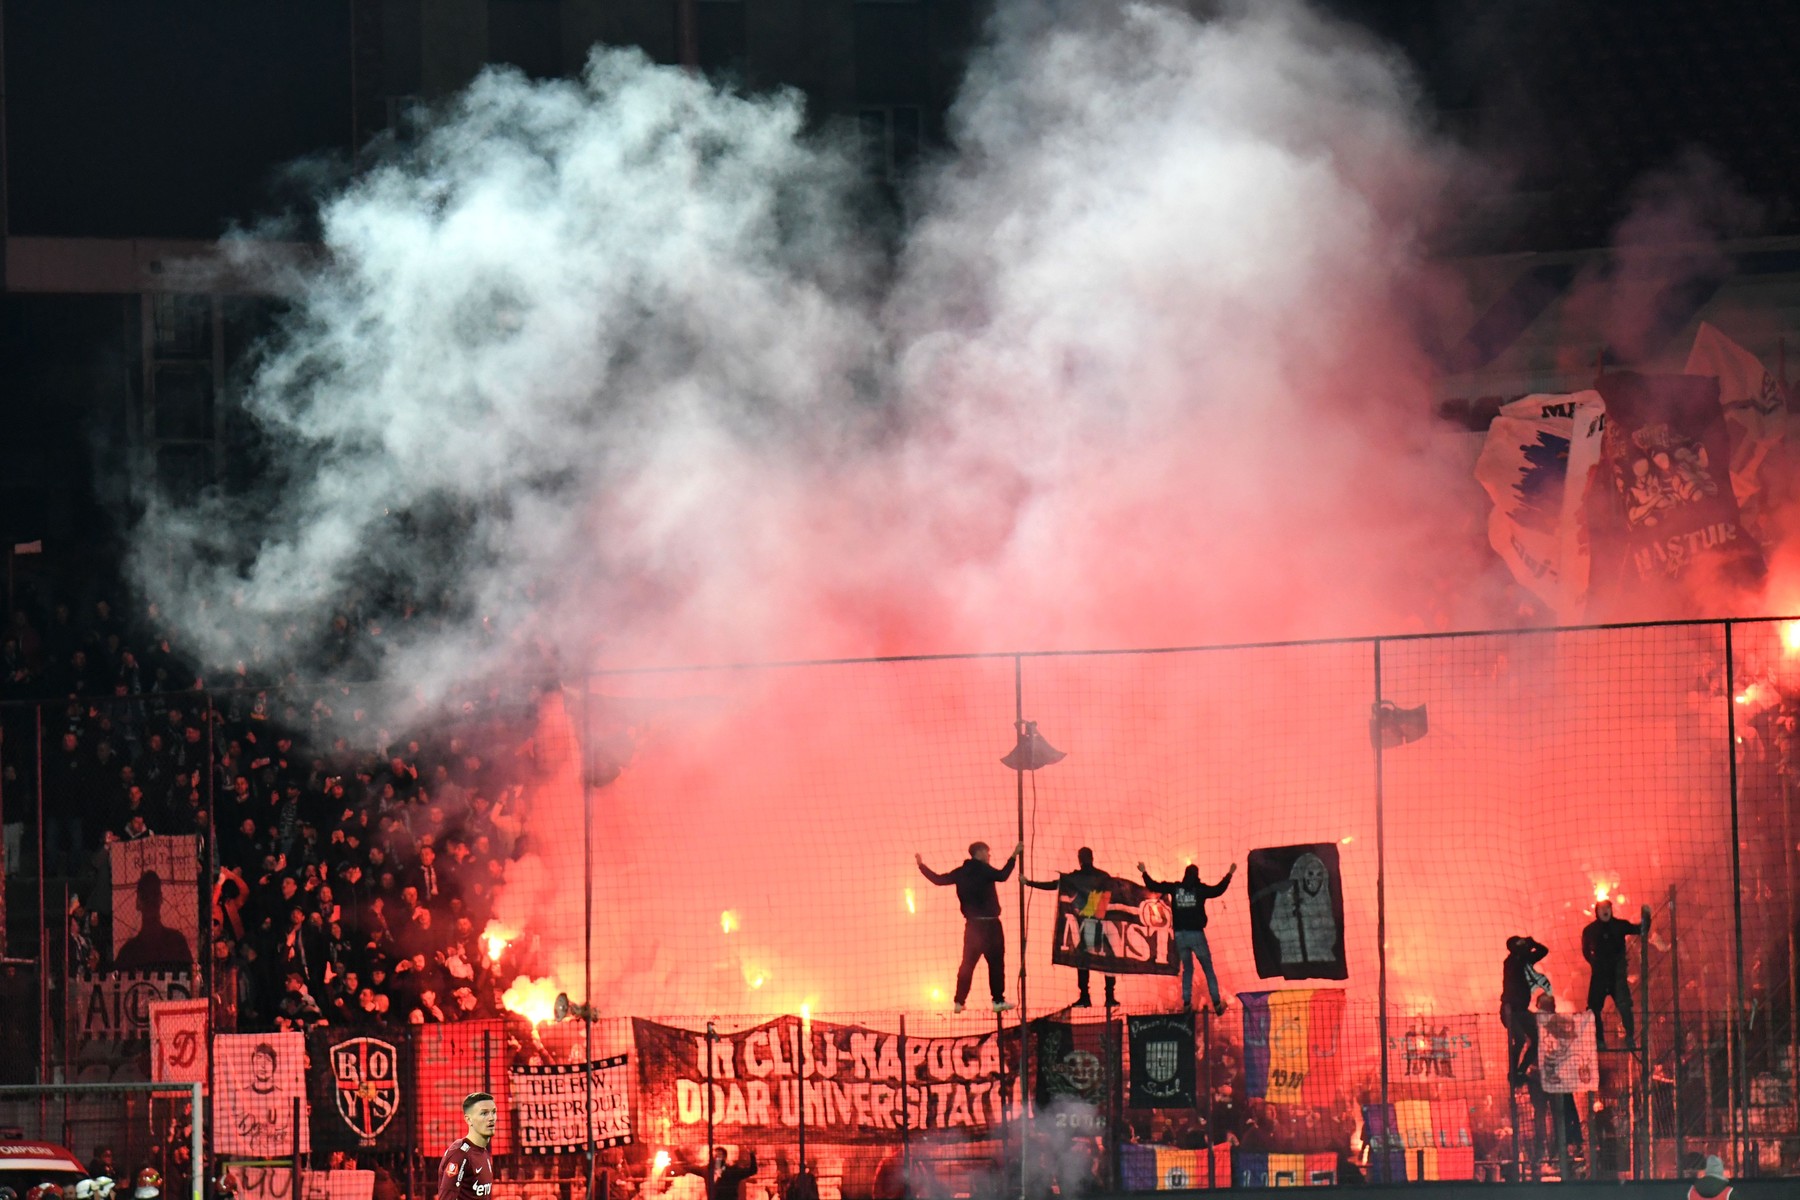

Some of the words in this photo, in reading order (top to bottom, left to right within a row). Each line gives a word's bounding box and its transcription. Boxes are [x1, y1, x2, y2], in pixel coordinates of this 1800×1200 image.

[1060, 913, 1174, 964] MNST
[744, 1024, 1010, 1082] CLUJ-NAPOCA
[526, 1079, 566, 1096] THE
[522, 1101, 559, 1120] THE
[521, 1125, 557, 1142] THE
